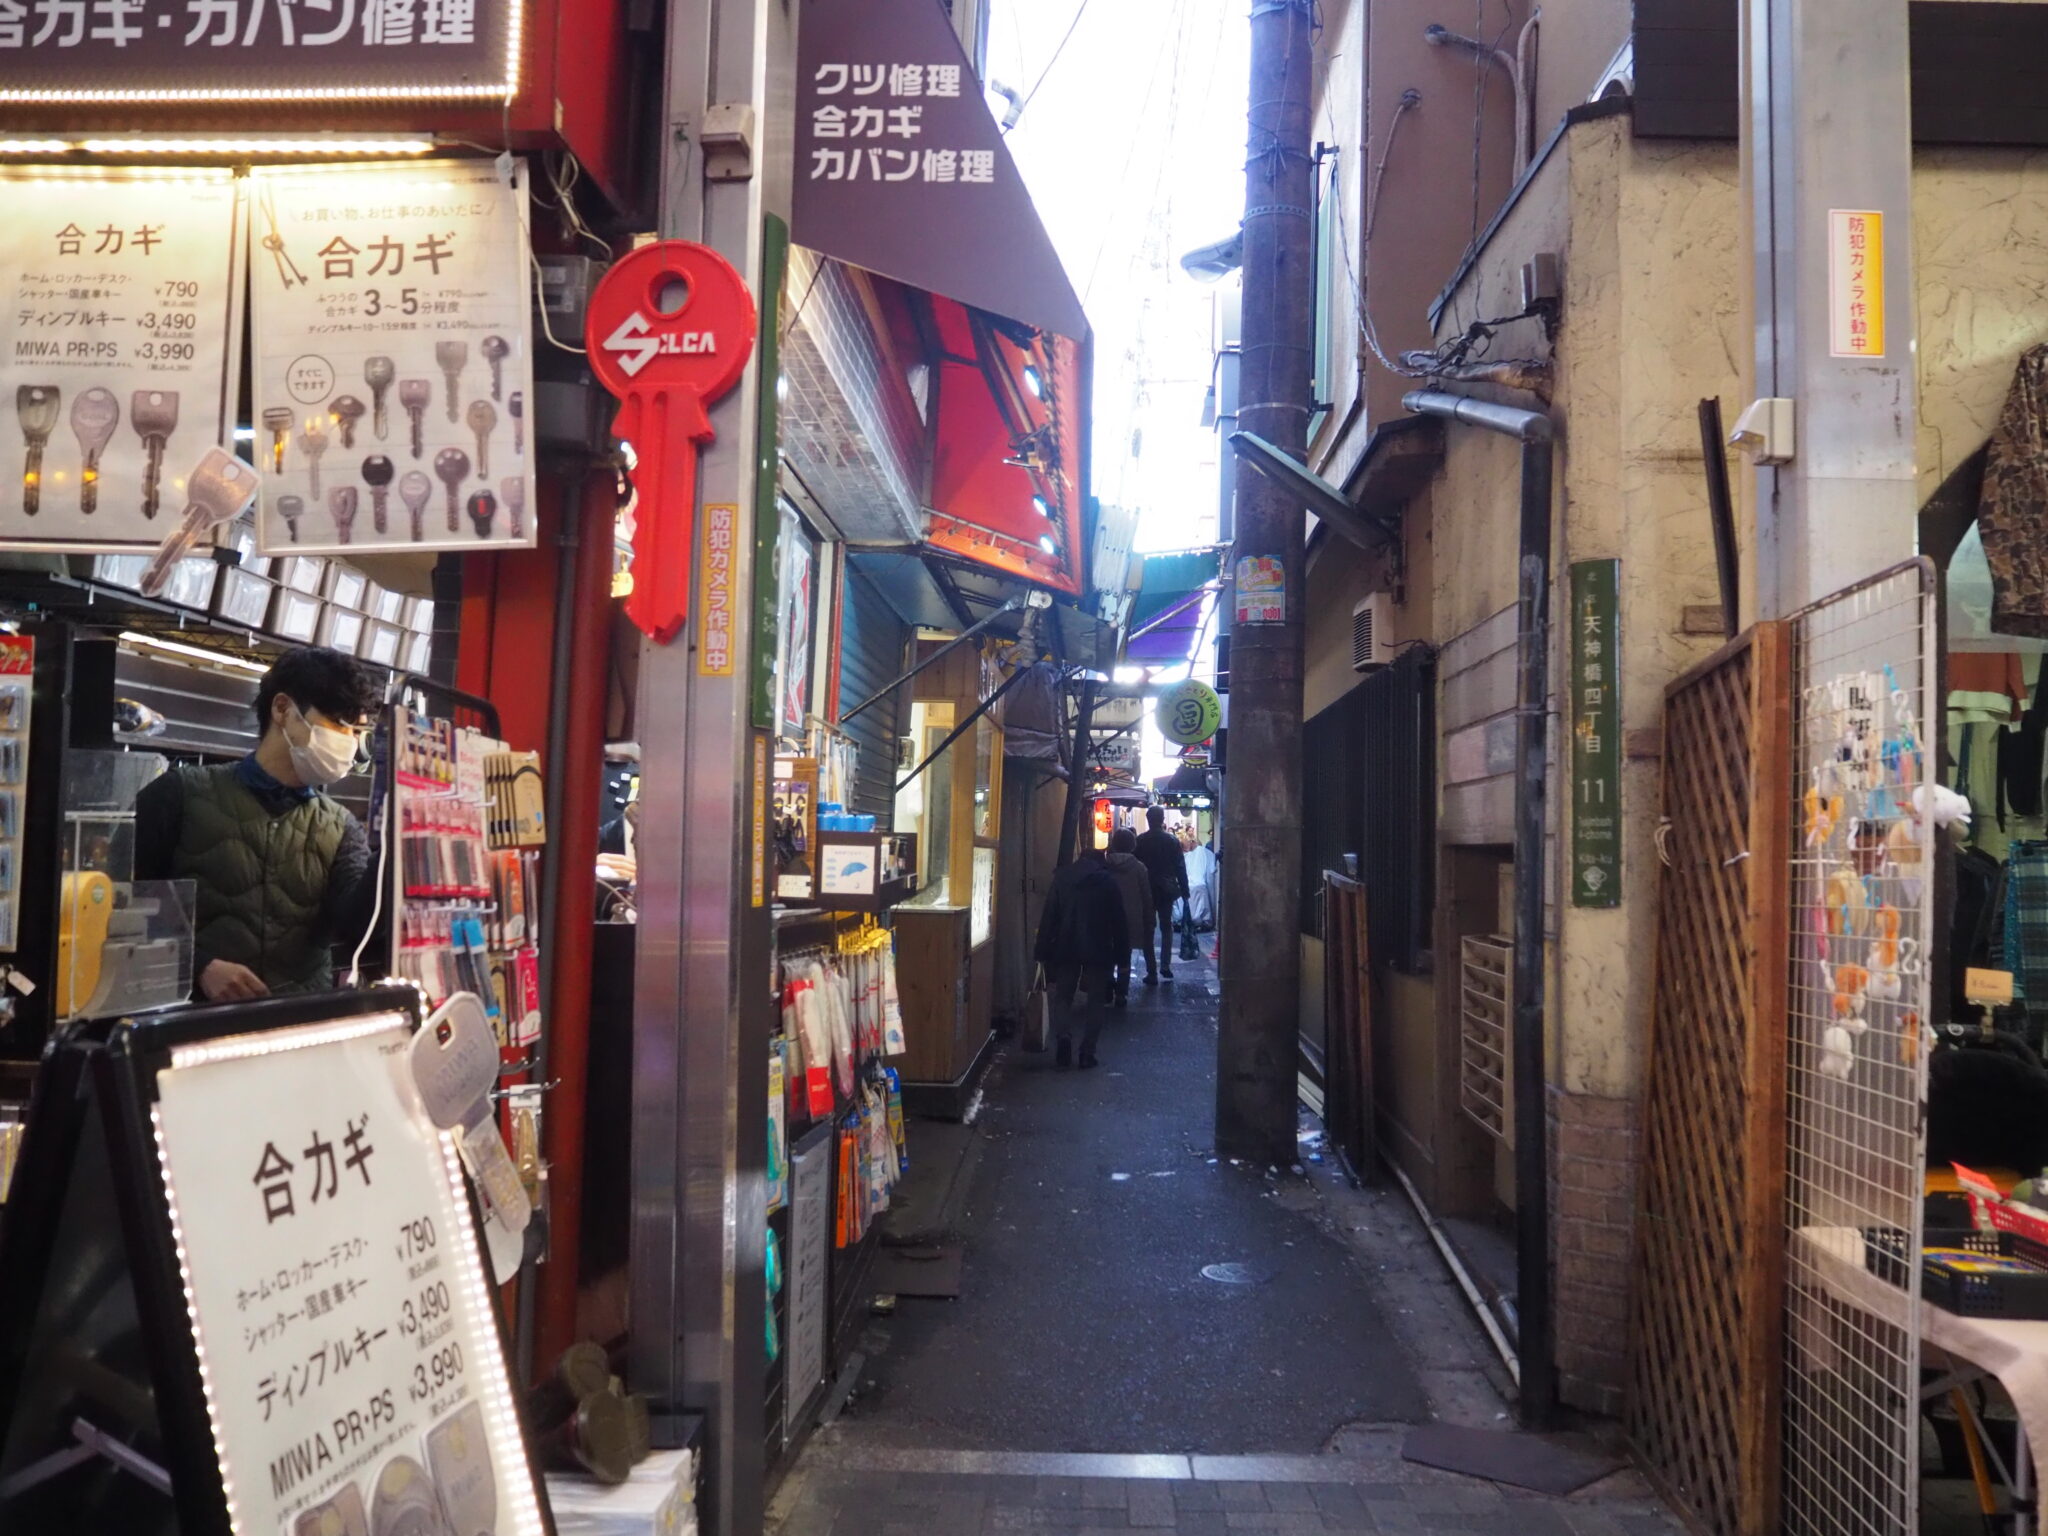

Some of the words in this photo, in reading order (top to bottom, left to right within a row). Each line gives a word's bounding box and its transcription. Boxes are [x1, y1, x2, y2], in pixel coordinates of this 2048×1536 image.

[815, 63, 961, 98] クツ修理
[812, 105, 922, 138] 合カギ
[810, 148, 995, 184] カバン修理
[55, 222, 166, 256] 合カギ
[317, 231, 456, 280] 合カギ
[1848, 216, 1867, 352] 防犯カメラ作動中
[18, 309, 126, 327] ディンプルキー
[16, 341, 60, 357] MIWA
[602, 311, 716, 377] SILCA
[706, 508, 733, 672] 防犯カメラ作動中
[1583, 616, 1602, 753] 天神橋四丁目
[1580, 777, 1605, 803] 11
[252, 1112, 374, 1225] 合カギ
[257, 1326, 387, 1422] ディンプルキー
[270, 1431, 333, 1500] MIWA
